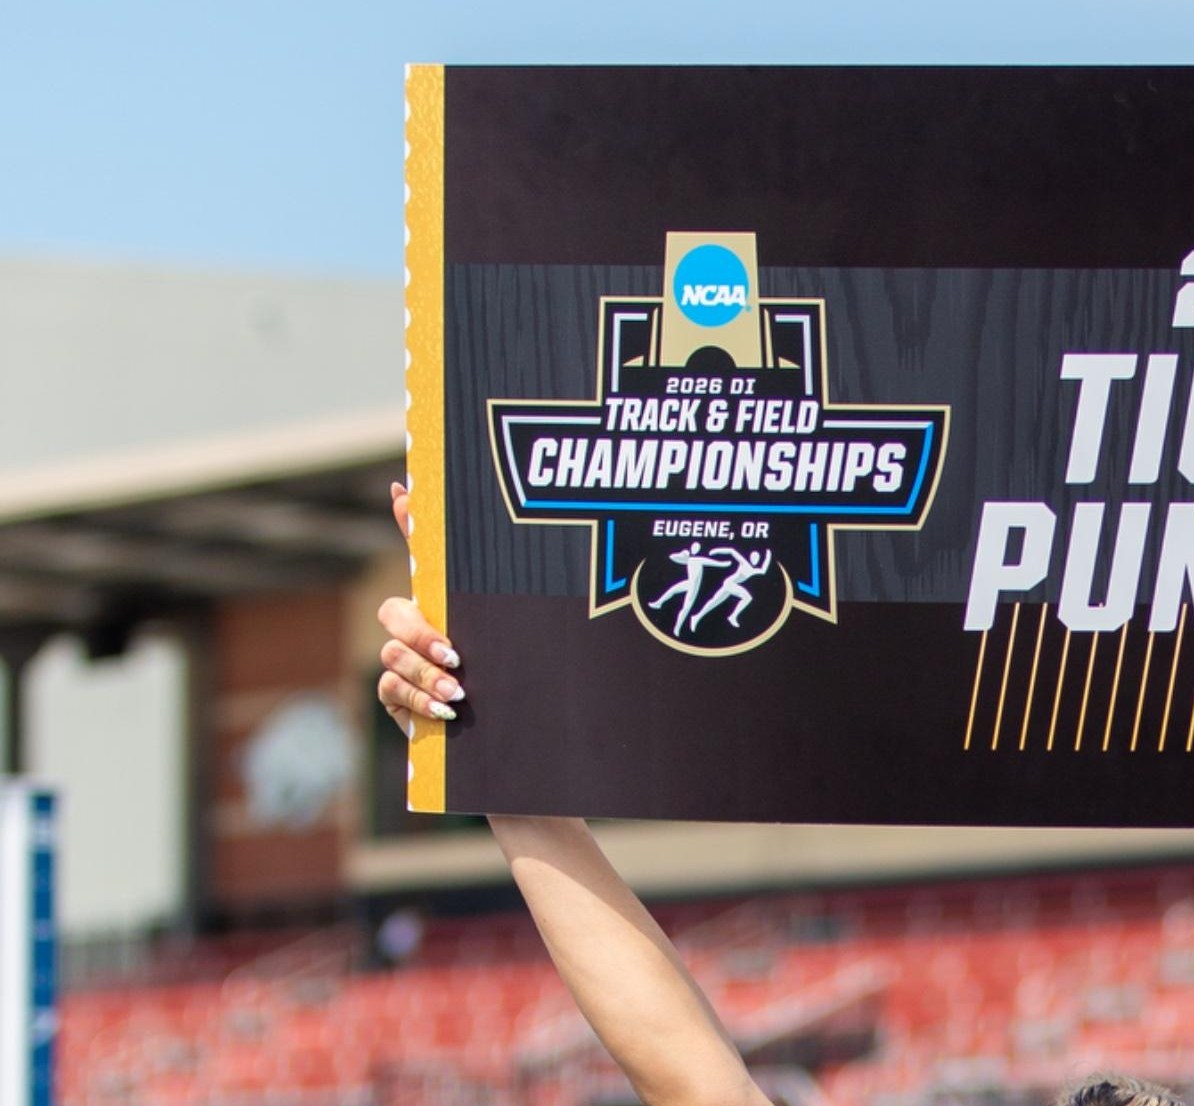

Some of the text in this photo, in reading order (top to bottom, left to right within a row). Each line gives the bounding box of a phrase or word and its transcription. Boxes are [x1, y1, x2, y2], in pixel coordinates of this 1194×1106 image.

[681, 284, 746, 306] NCAA
[665, 377, 757, 395] 2026 DI
[605, 397, 820, 434] TRACK & FIELD
[527, 437, 907, 493] CHAMPIONSHIPS
[652, 519, 769, 540] EUGENE, OR
